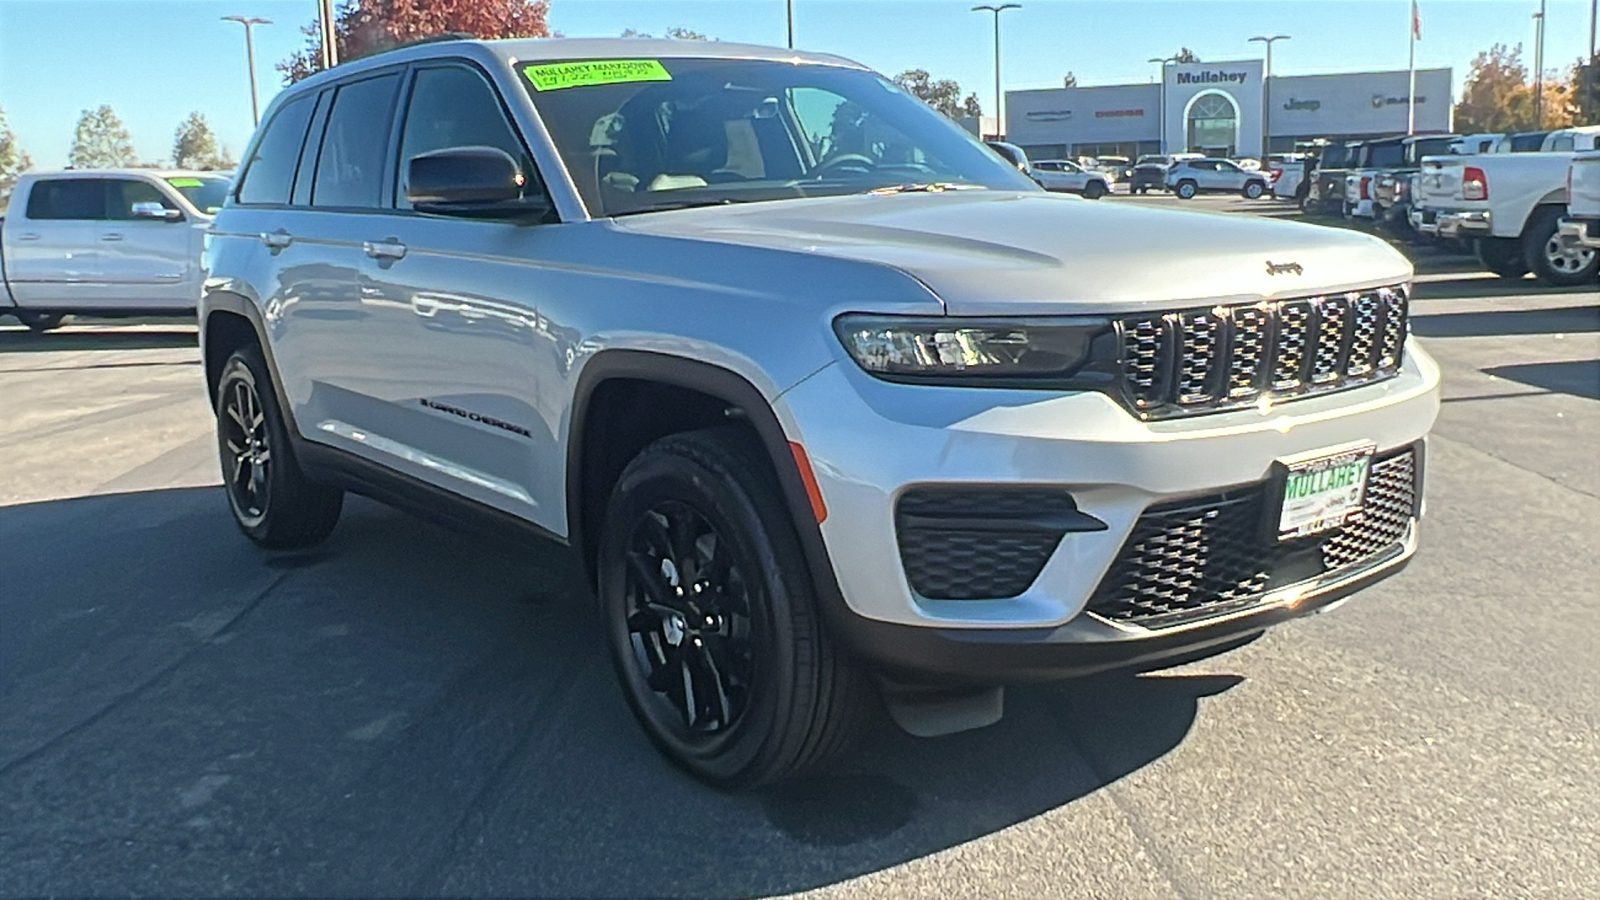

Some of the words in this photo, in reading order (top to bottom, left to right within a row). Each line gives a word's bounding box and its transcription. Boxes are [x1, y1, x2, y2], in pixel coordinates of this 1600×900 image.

[1177, 70, 1247, 84] Mullahey
[1265, 260, 1303, 276] Jeep
[1285, 461, 1367, 500] MULLAHEY
